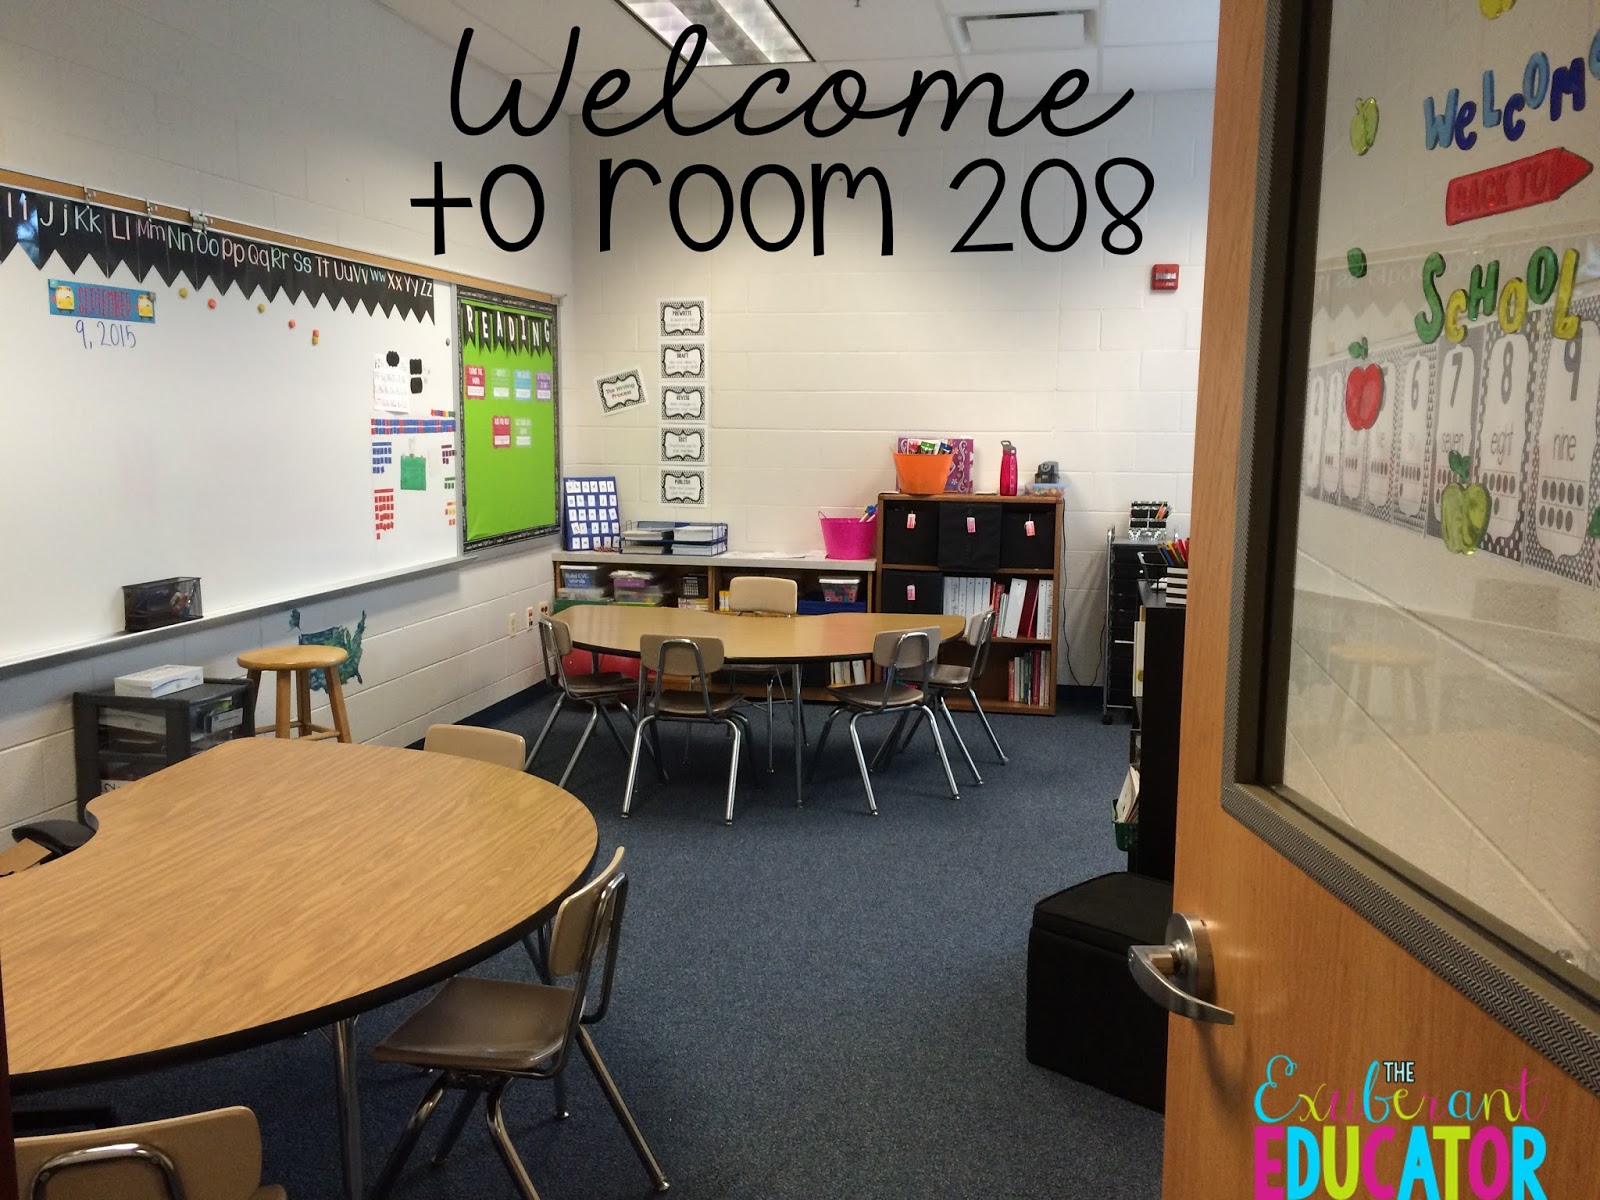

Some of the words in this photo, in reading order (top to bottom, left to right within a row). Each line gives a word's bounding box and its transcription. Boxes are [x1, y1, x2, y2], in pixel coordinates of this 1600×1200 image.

[1456, 170, 1511, 212] BACK
[1519, 160, 1549, 200] TO
[96, 320, 137, 349] 2015
[465, 304, 550, 347] READING
[1451, 351, 1464, 408] 7
[1500, 341, 1513, 405] 8
[1564, 326, 1583, 402] 9
[612, 390, 631, 399] Process
[616, 383, 635, 392] Writing
[1441, 431, 1464, 453] seven
[1553, 426, 1577, 462] nine
